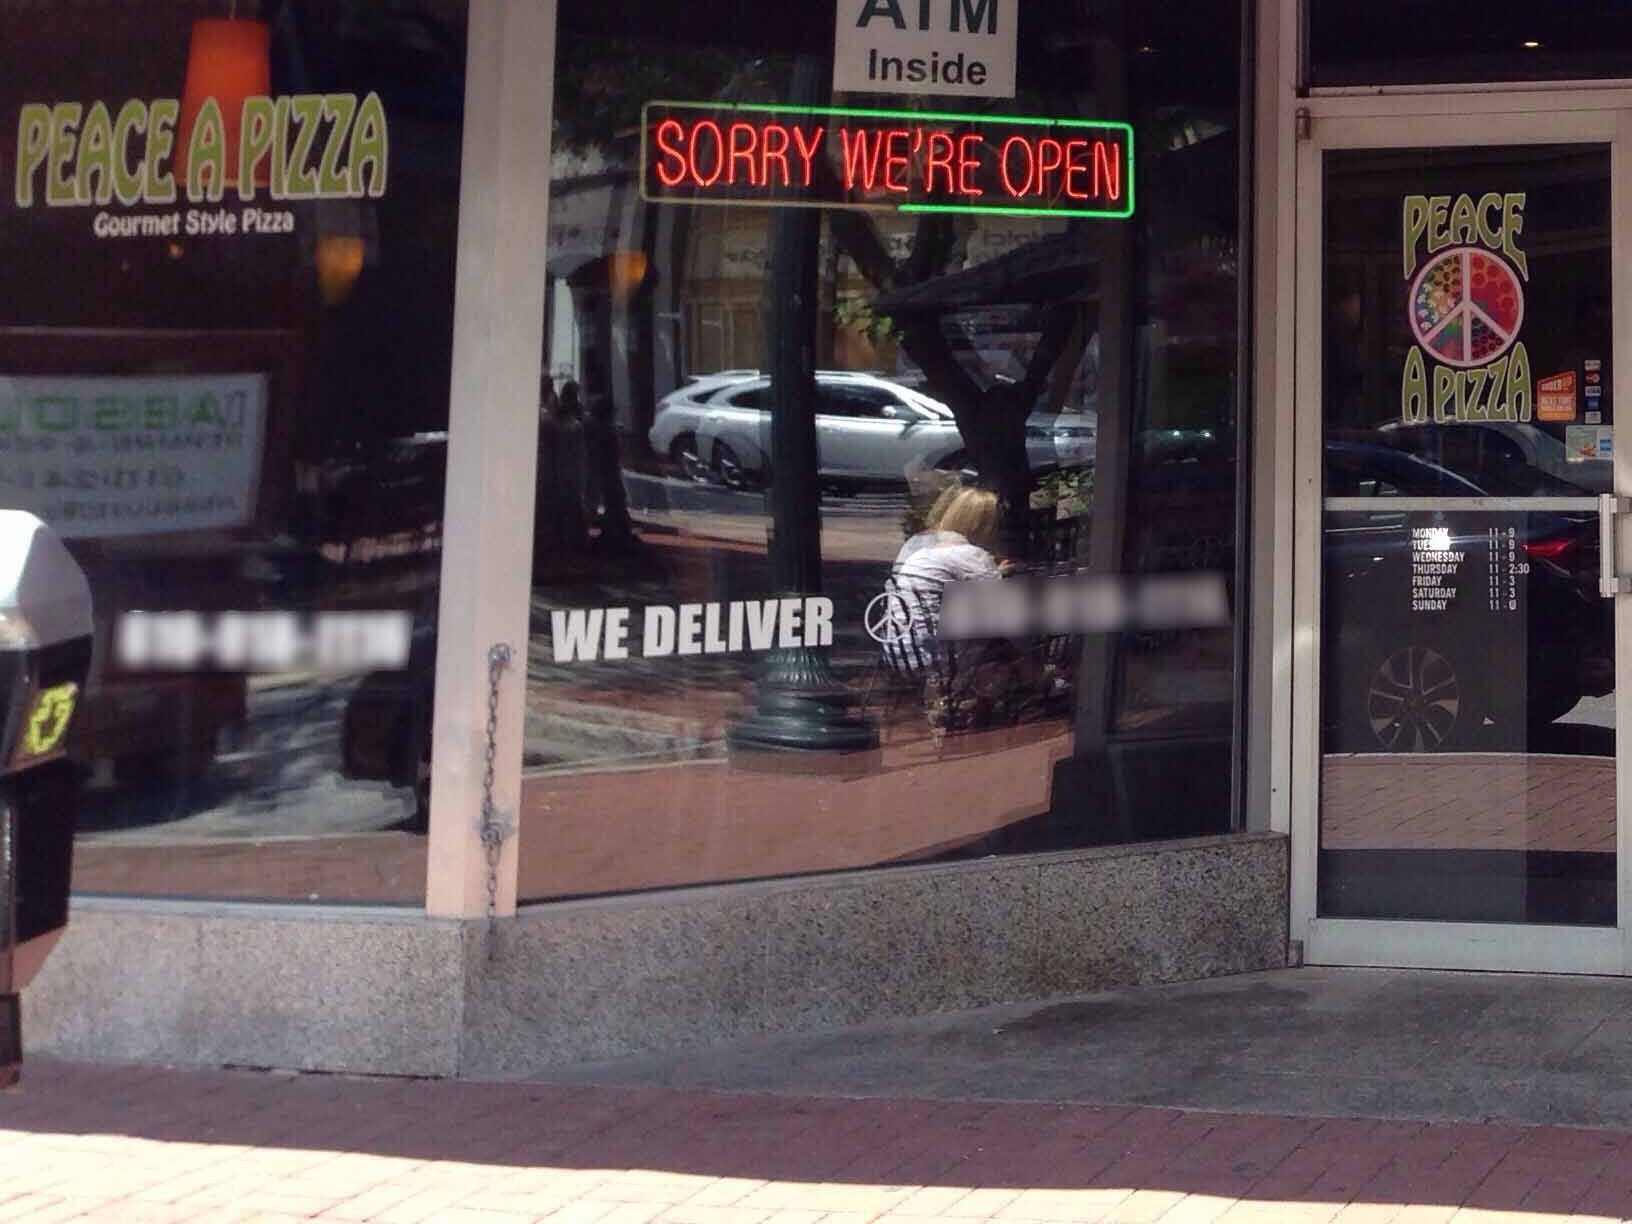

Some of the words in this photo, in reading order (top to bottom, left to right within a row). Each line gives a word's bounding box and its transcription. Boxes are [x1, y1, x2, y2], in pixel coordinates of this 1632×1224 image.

[868, 48, 987, 86] Inside
[16, 97, 180, 207] PEACE
[187, 96, 225, 201] A
[238, 91, 388, 200] PIZZA
[656, 120, 824, 188] SORRY
[840, 127, 984, 196] WE'RE
[1001, 135, 1120, 201] OPEN
[93, 211, 181, 238] Gourmet
[185, 208, 238, 235] Style
[242, 208, 295, 233] Pizza
[1403, 192, 1528, 281] PEACE
[1402, 345, 1427, 424] A
[1433, 341, 1532, 424] PIZZA
[1412, 527, 1449, 538] MONDAY
[1412, 551, 1464, 562] WEDNESDAY
[1412, 564, 1458, 574] THURSDAY
[1412, 576, 1442, 586] FRIDAY
[1412, 588, 1456, 598] SATURDAY
[1412, 600, 1447, 610] SUNDAY
[550, 610, 629, 663] WE
[642, 597, 833, 657] DELIVER
